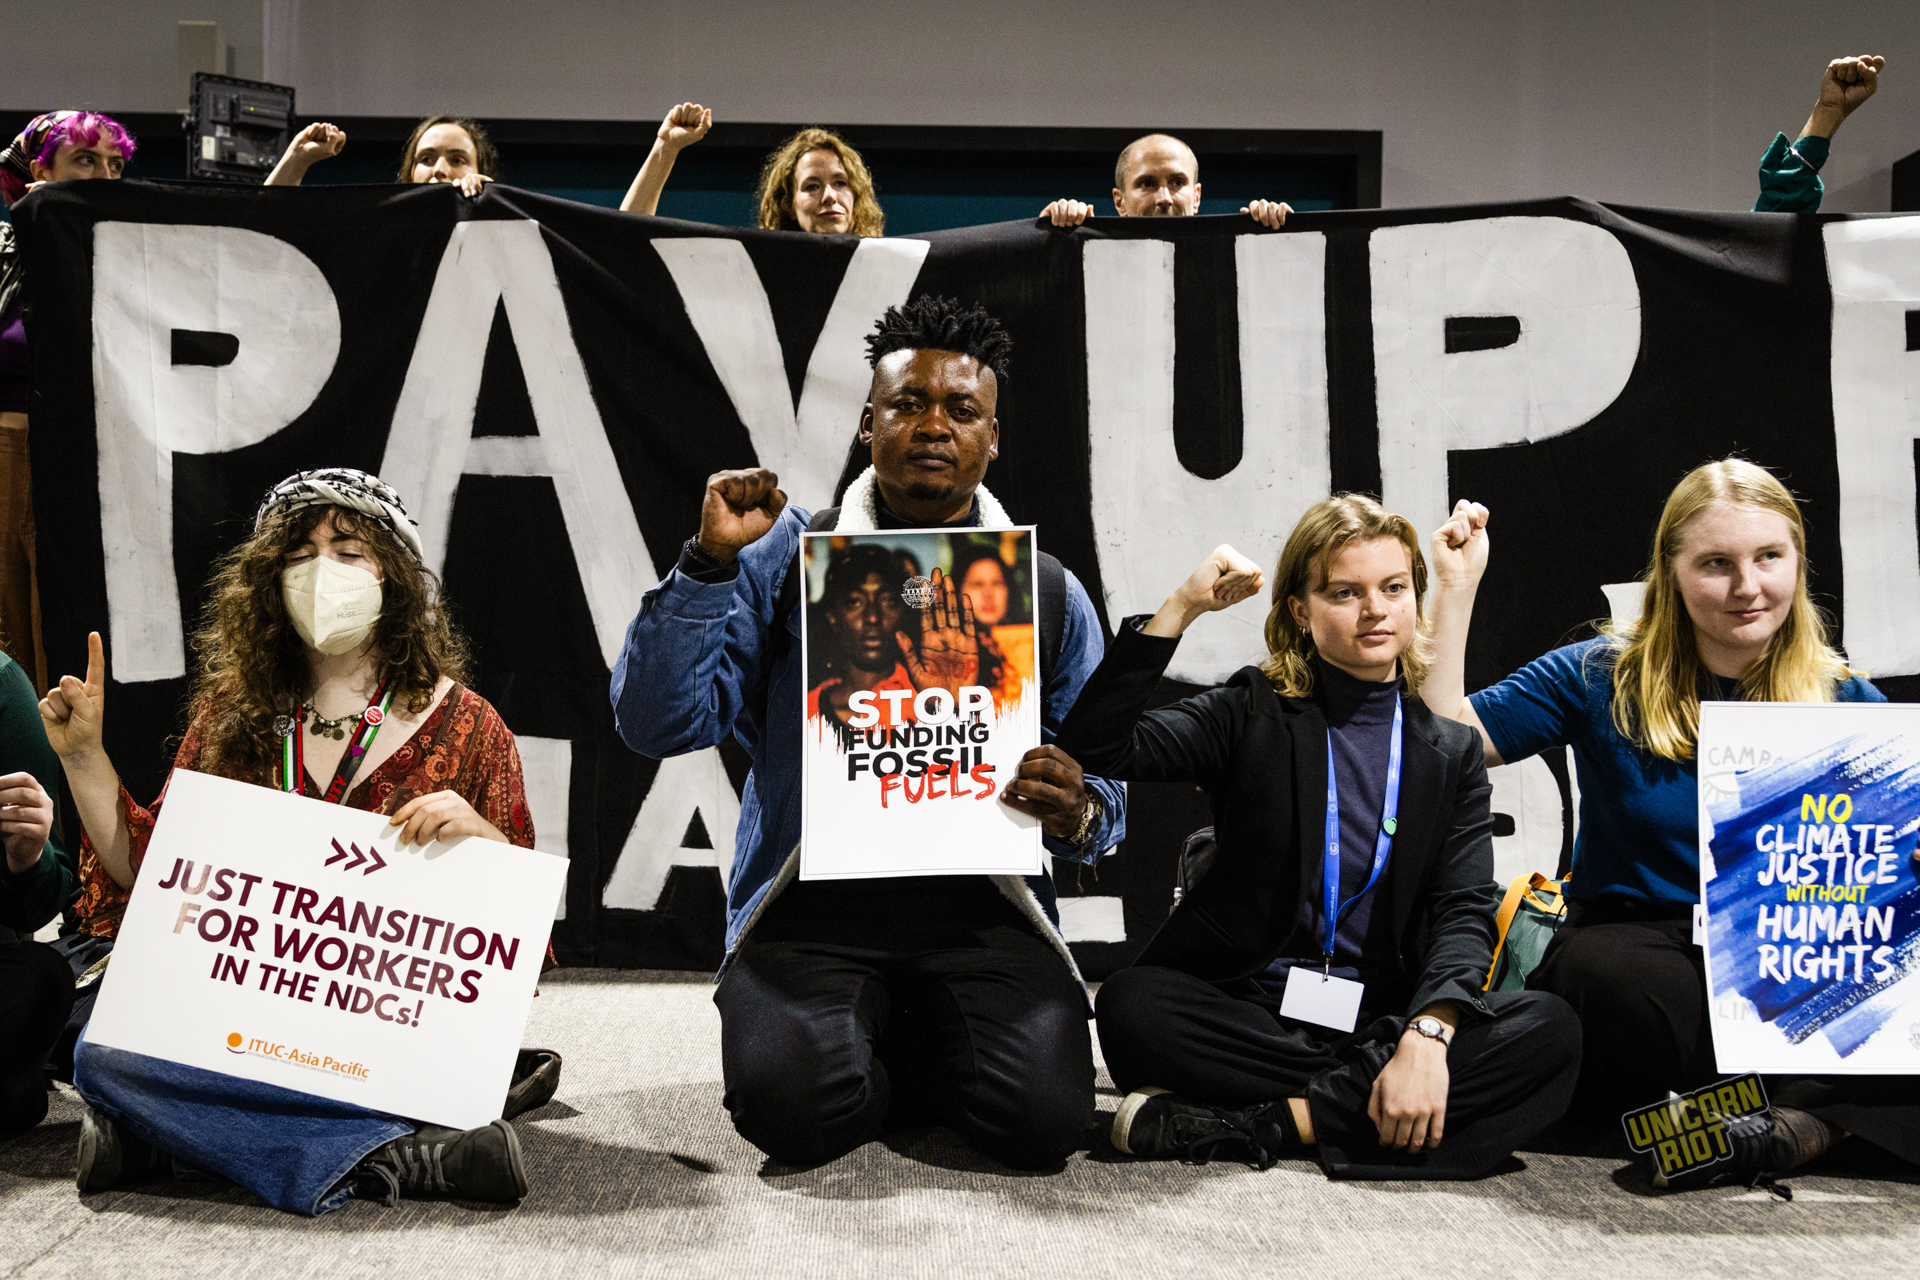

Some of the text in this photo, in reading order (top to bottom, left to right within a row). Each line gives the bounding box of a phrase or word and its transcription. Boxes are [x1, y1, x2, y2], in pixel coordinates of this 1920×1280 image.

[93, 219, 931, 682] PAY
[848, 685, 992, 728] STOP
[848, 722, 989, 751] FUNDING
[848, 746, 996, 781] FOSSIL
[880, 760, 996, 809] FUELS
[1801, 793, 1853, 824] NO
[1756, 823, 1895, 855] CLIMATE
[1757, 851, 1899, 886] JUSTICE
[1787, 883, 1870, 904] WITHOUT
[158, 858, 520, 971] JUST TRANSITION
[1757, 904, 1895, 943] HUMAN
[173, 901, 483, 1004] FOR WORKERS
[1757, 944, 1895, 984] RIGHTS
[211, 953, 424, 1028] IN THE NDCs!
[248, 1038, 370, 1078] ITUC-Asia Pacific
